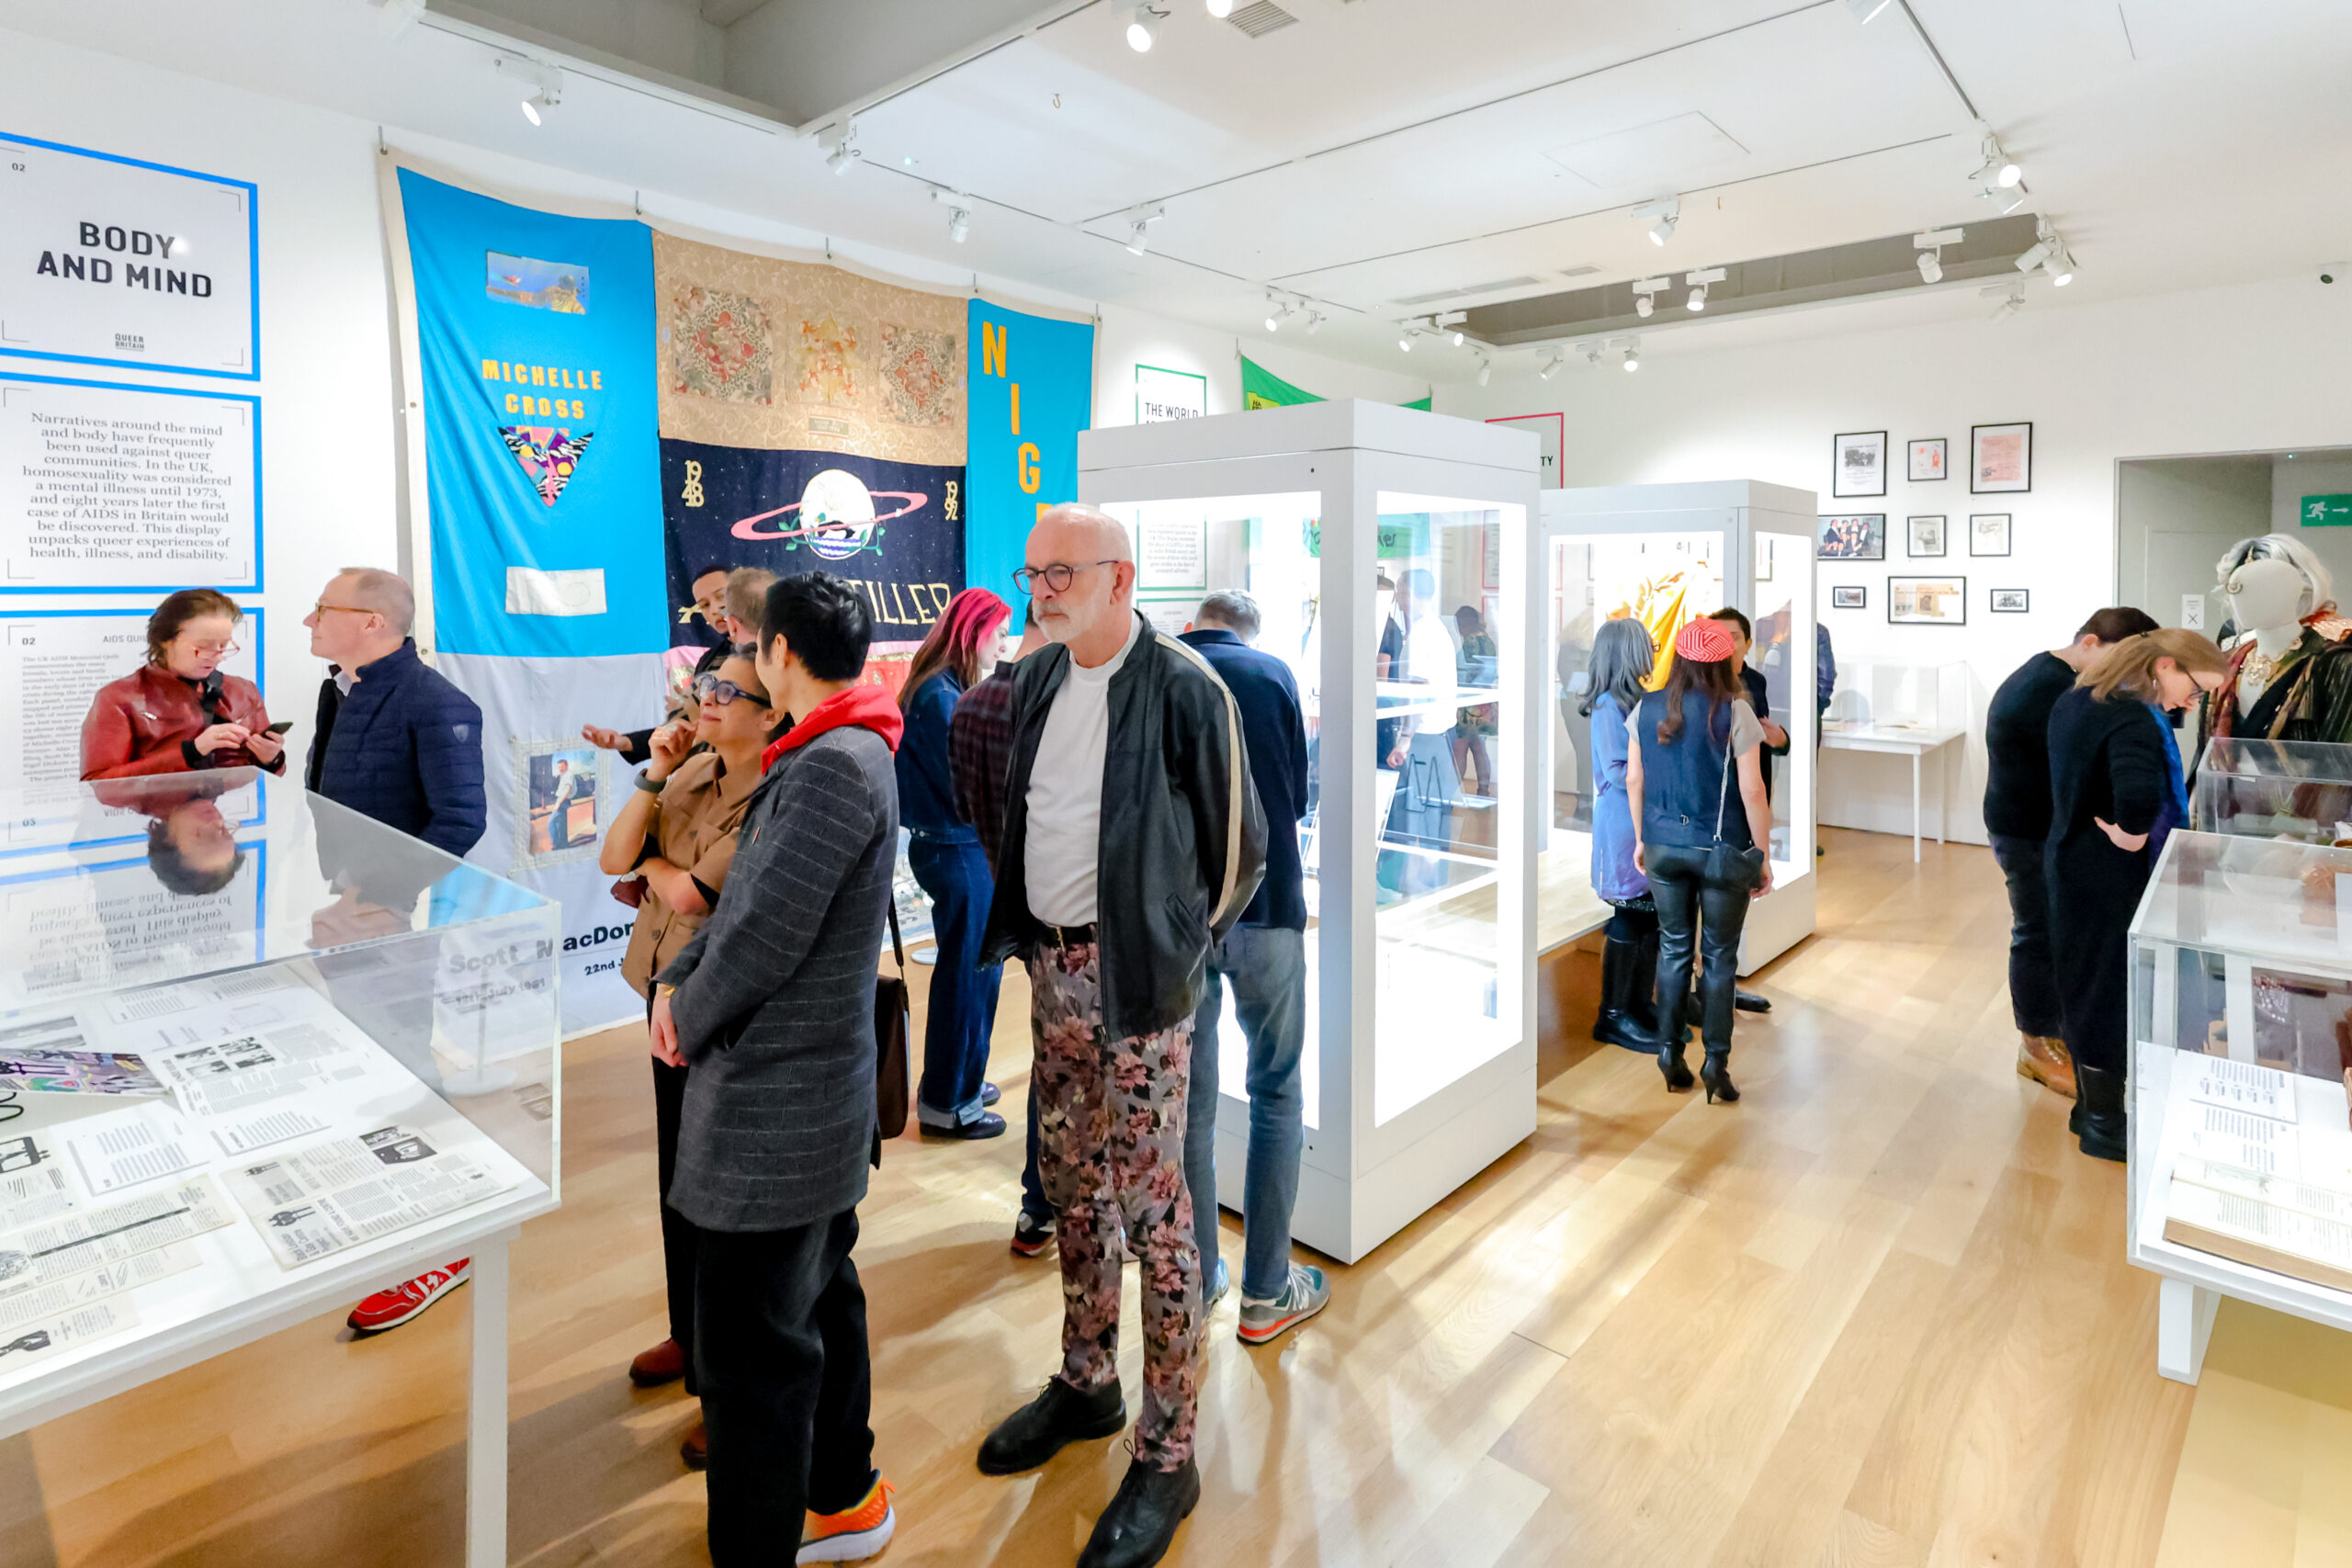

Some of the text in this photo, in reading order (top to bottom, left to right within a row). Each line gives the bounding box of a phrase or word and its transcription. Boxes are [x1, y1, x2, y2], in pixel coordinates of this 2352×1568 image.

[12, 163, 26, 172] 02
[79, 220, 175, 259] BODY
[37, 250, 212, 299] AND MIND
[115, 333, 144, 343] QUEER
[115, 341, 144, 350] BRITAIN
[481, 358, 603, 390] MICHELLE
[504, 392, 586, 420] CROSS
[1145, 402, 1198, 420] THE WORLD
[31, 412, 222, 435] Narratives around the mind
[982, 321, 1052, 521] NIG
[41, 427, 215, 449] and body have frequently
[46, 440, 211, 460] been used against queer
[44, 456, 213, 474] communities. In the UK,
[1540, 455, 1554, 467] TY
[23, 465, 232, 486] homosexuality was considered
[36, 482, 221, 499] a mental illness until 1973,
[30, 493, 226, 510] and eight years later the first
[27, 507, 229, 523] case of AIDS in Britain would
[38, 520, 221, 536] be discovered. This display
[28, 534, 232, 548] unpacks queer experiences of
[30, 547, 228, 561] health, illness, and disability.
[850, 580, 951, 625] ILLER
[22, 637, 36, 646] 02
[103, 635, 124, 643] AIDS
[449, 945, 518, 974] Scott
[584, 960, 616, 976] 22nd
